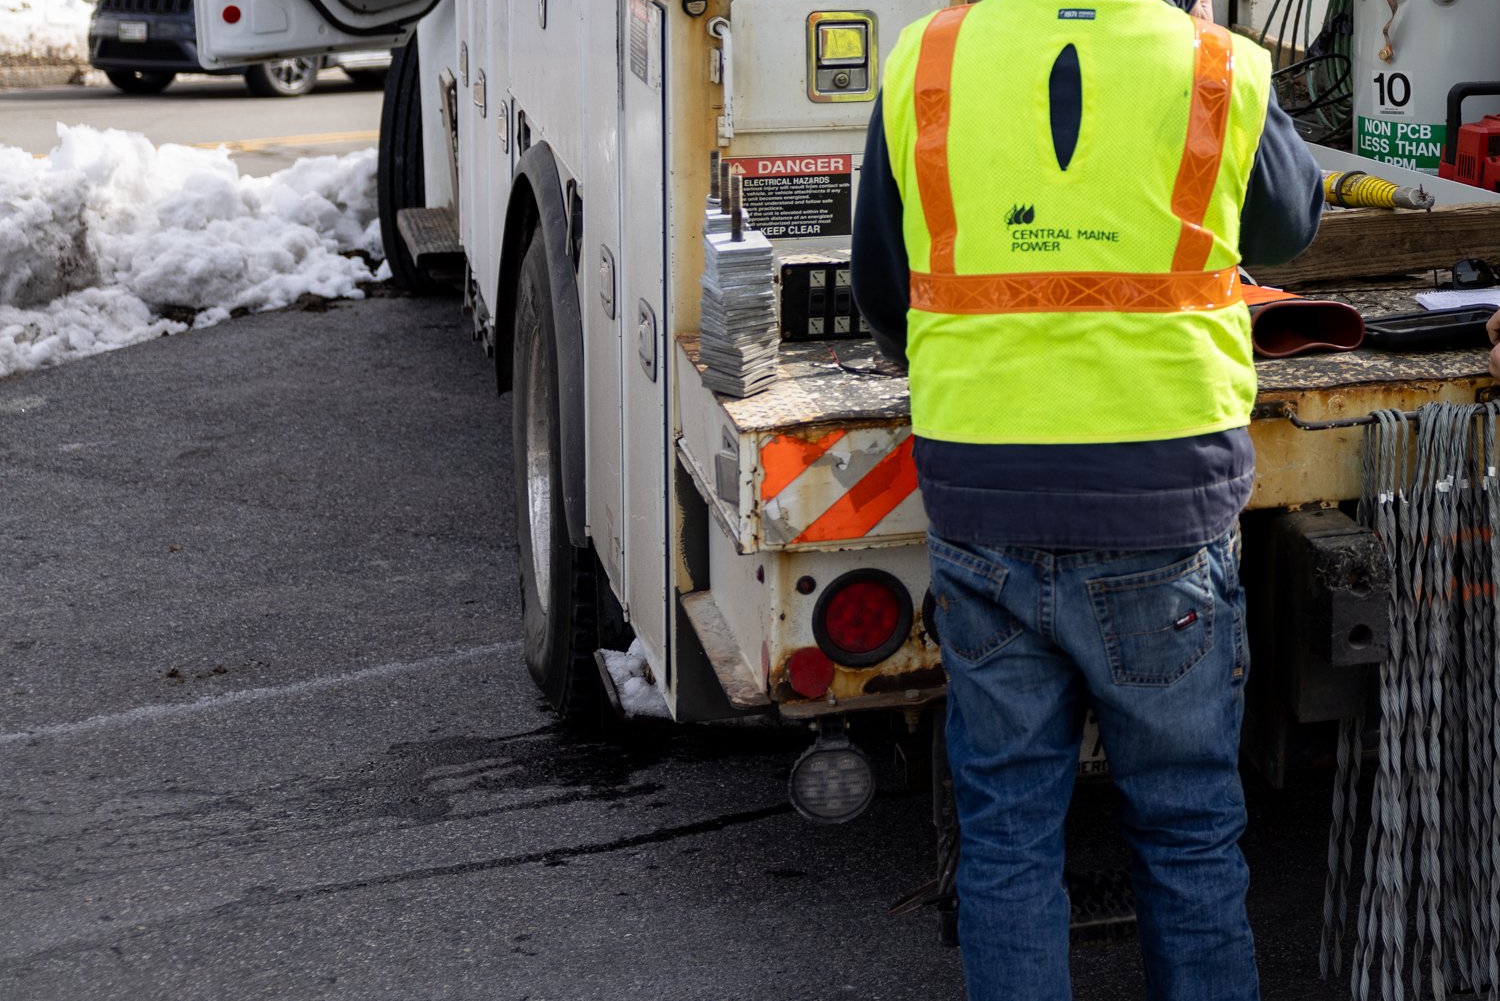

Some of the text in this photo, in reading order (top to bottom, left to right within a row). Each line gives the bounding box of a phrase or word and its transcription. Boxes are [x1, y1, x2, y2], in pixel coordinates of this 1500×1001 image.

[1373, 72, 1411, 107] 10
[1364, 119, 1432, 139] NON PCB
[1360, 134, 1441, 157] LESS THAN
[757, 158, 844, 174] DANGER
[744, 176, 830, 187] ELECTRICAL HAZARDS
[760, 224, 820, 236] KEEP CLEAR
[1011, 229, 1120, 242] CENTRAL MAINE
[1011, 241, 1060, 252] POWER
